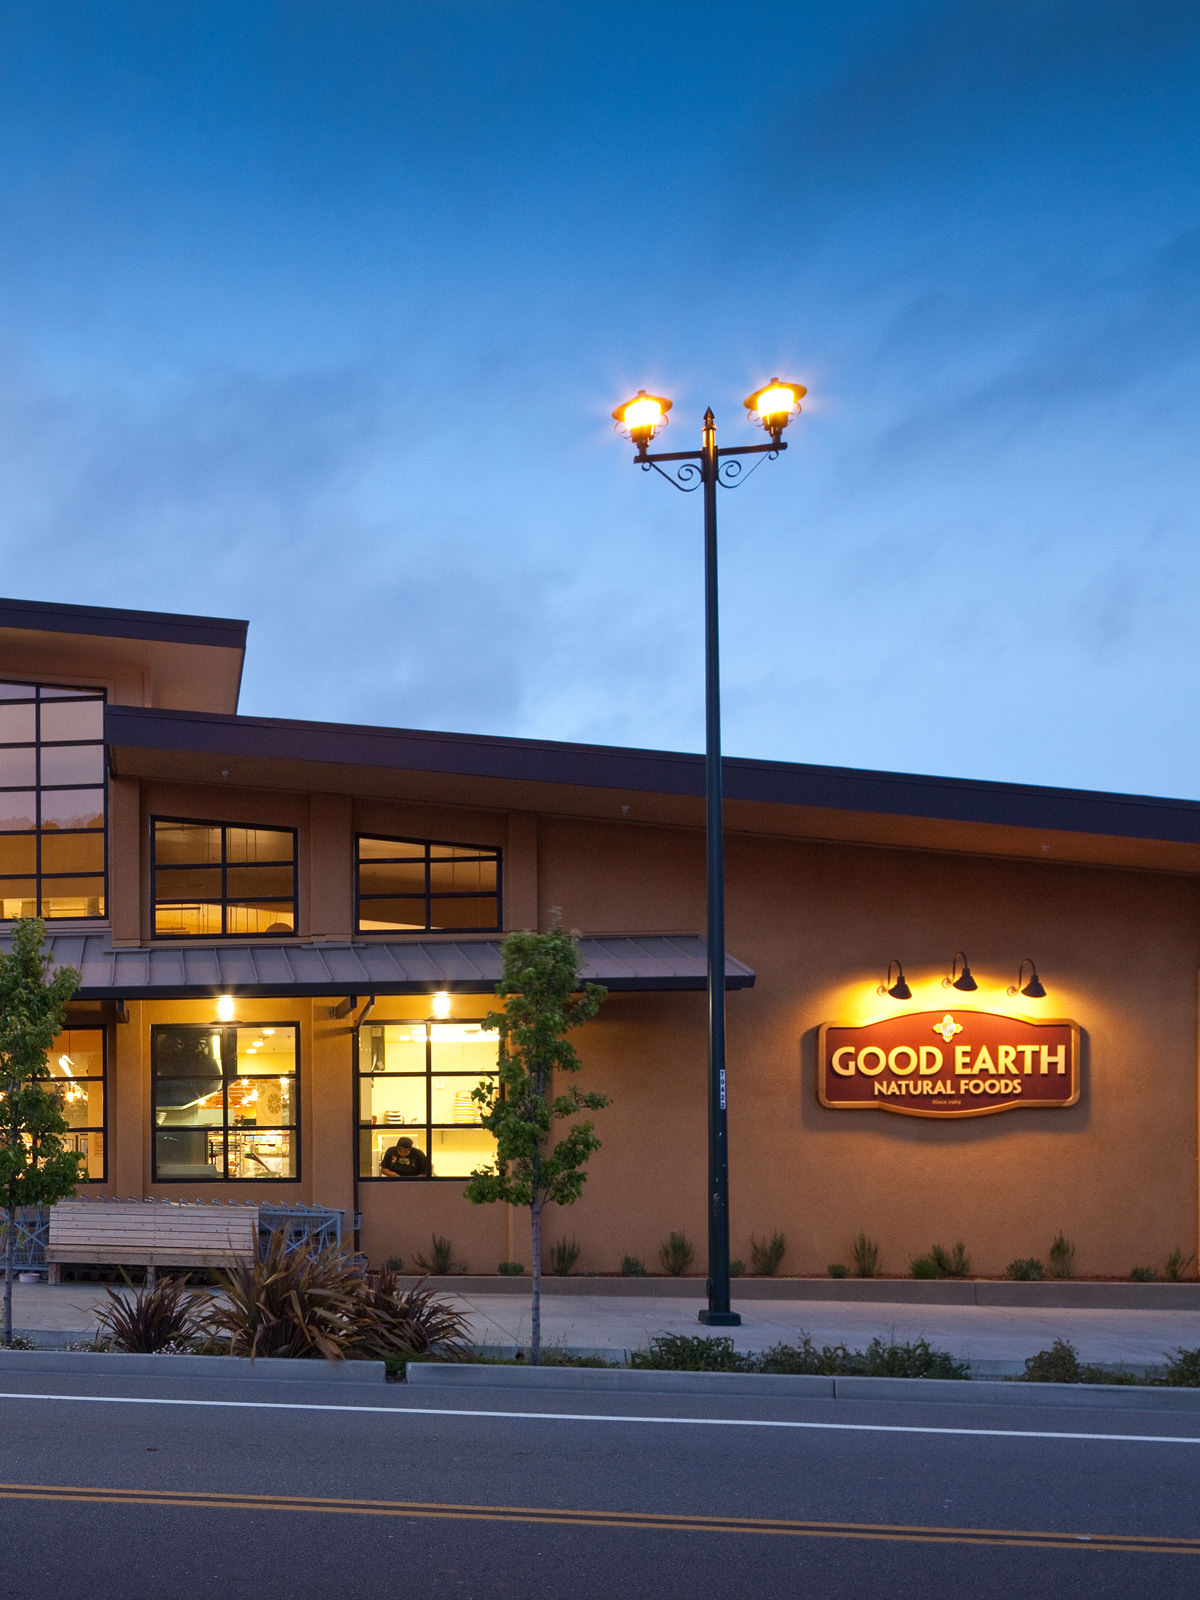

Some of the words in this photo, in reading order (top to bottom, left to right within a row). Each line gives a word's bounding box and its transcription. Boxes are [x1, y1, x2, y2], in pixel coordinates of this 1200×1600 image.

[831, 1046, 944, 1076] GOOD
[954, 1045, 1066, 1075] EARTH
[874, 1080, 955, 1096] NATURAL
[960, 1079, 1022, 1095] FOODS
